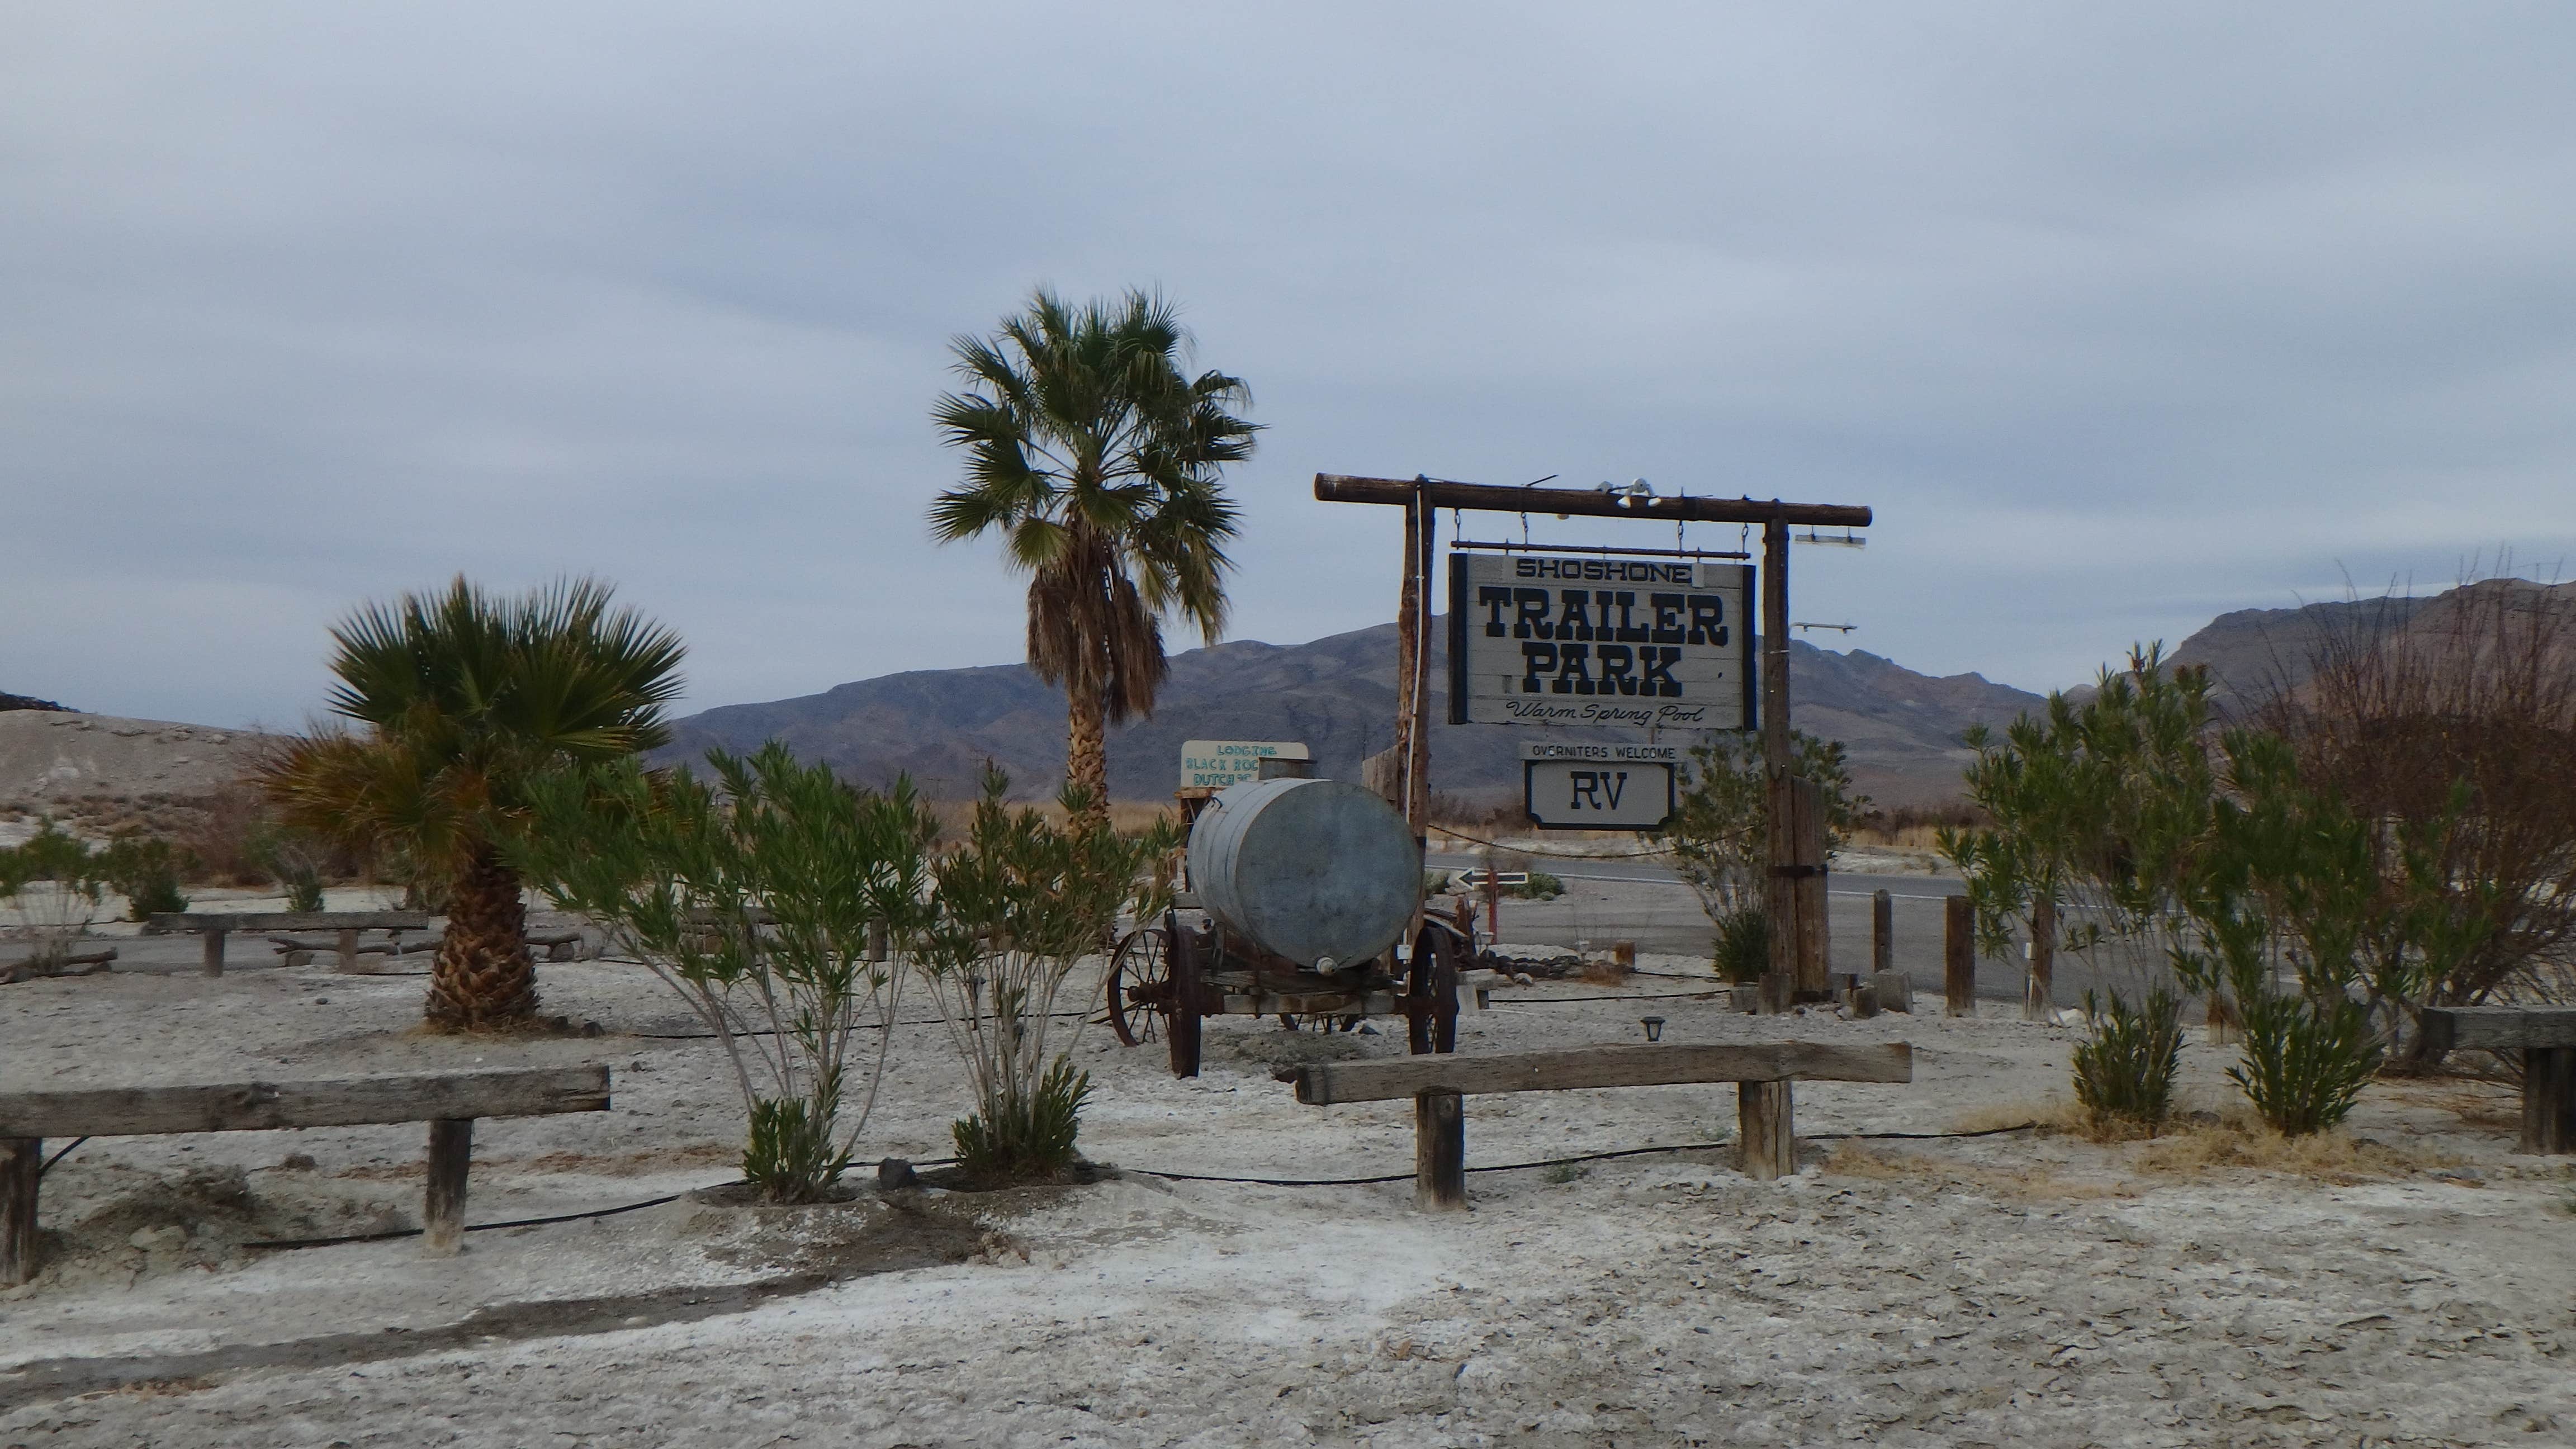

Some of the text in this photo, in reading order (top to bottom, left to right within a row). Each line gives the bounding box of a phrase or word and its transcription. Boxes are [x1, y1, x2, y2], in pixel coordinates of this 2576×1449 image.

[1516, 558, 1692, 584] SHOSHONE
[1479, 586, 1728, 646] TRAILER
[1521, 641, 1683, 697] PARK
[1506, 701, 1704, 726] Warm Spring Pool
[1216, 745, 1277, 757] LODGING
[1532, 745, 1676, 760] OVERNITERS WELCOME
[1185, 757, 1259, 771] BLACK ROC
[1570, 771, 1628, 810] RV
